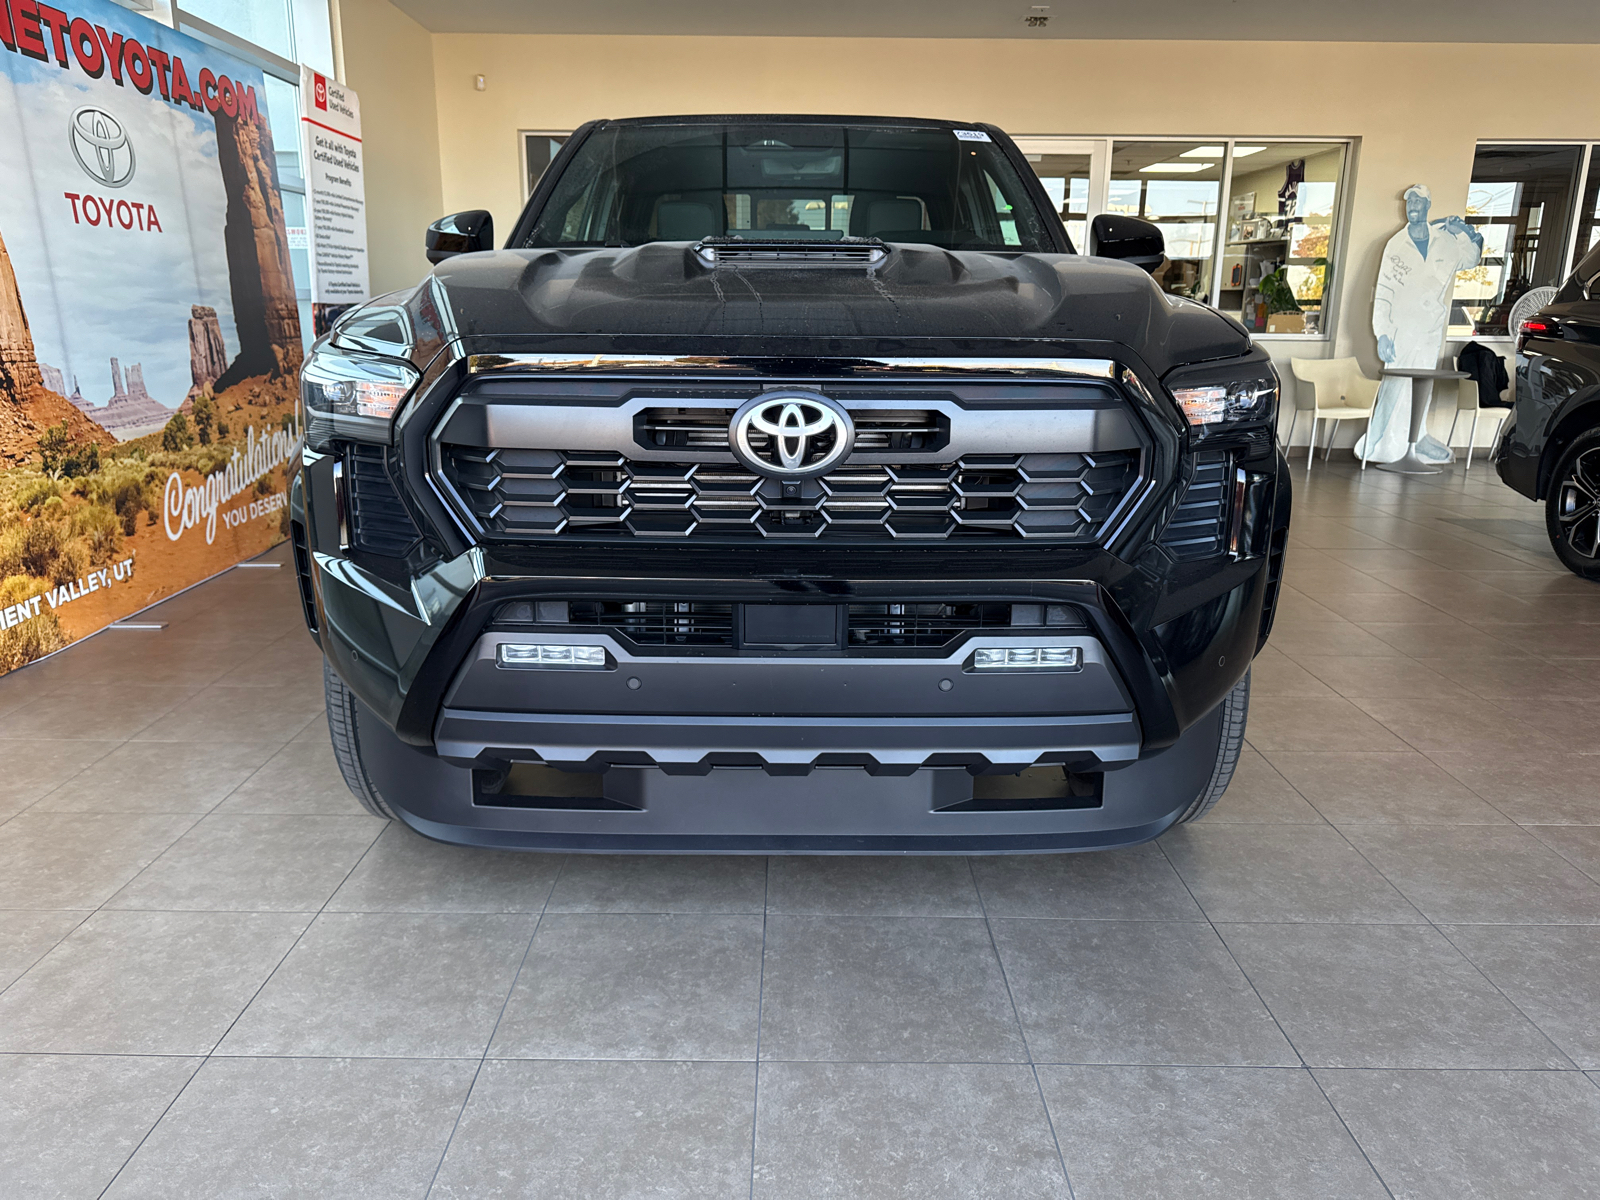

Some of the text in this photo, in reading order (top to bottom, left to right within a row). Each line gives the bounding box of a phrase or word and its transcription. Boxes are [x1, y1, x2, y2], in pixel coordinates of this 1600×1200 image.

[64, 192, 163, 233] TOYOTA
[222, 506, 248, 530] YOU
[44, 567, 112, 609] VALLEY,
[112, 558, 134, 581] UT
